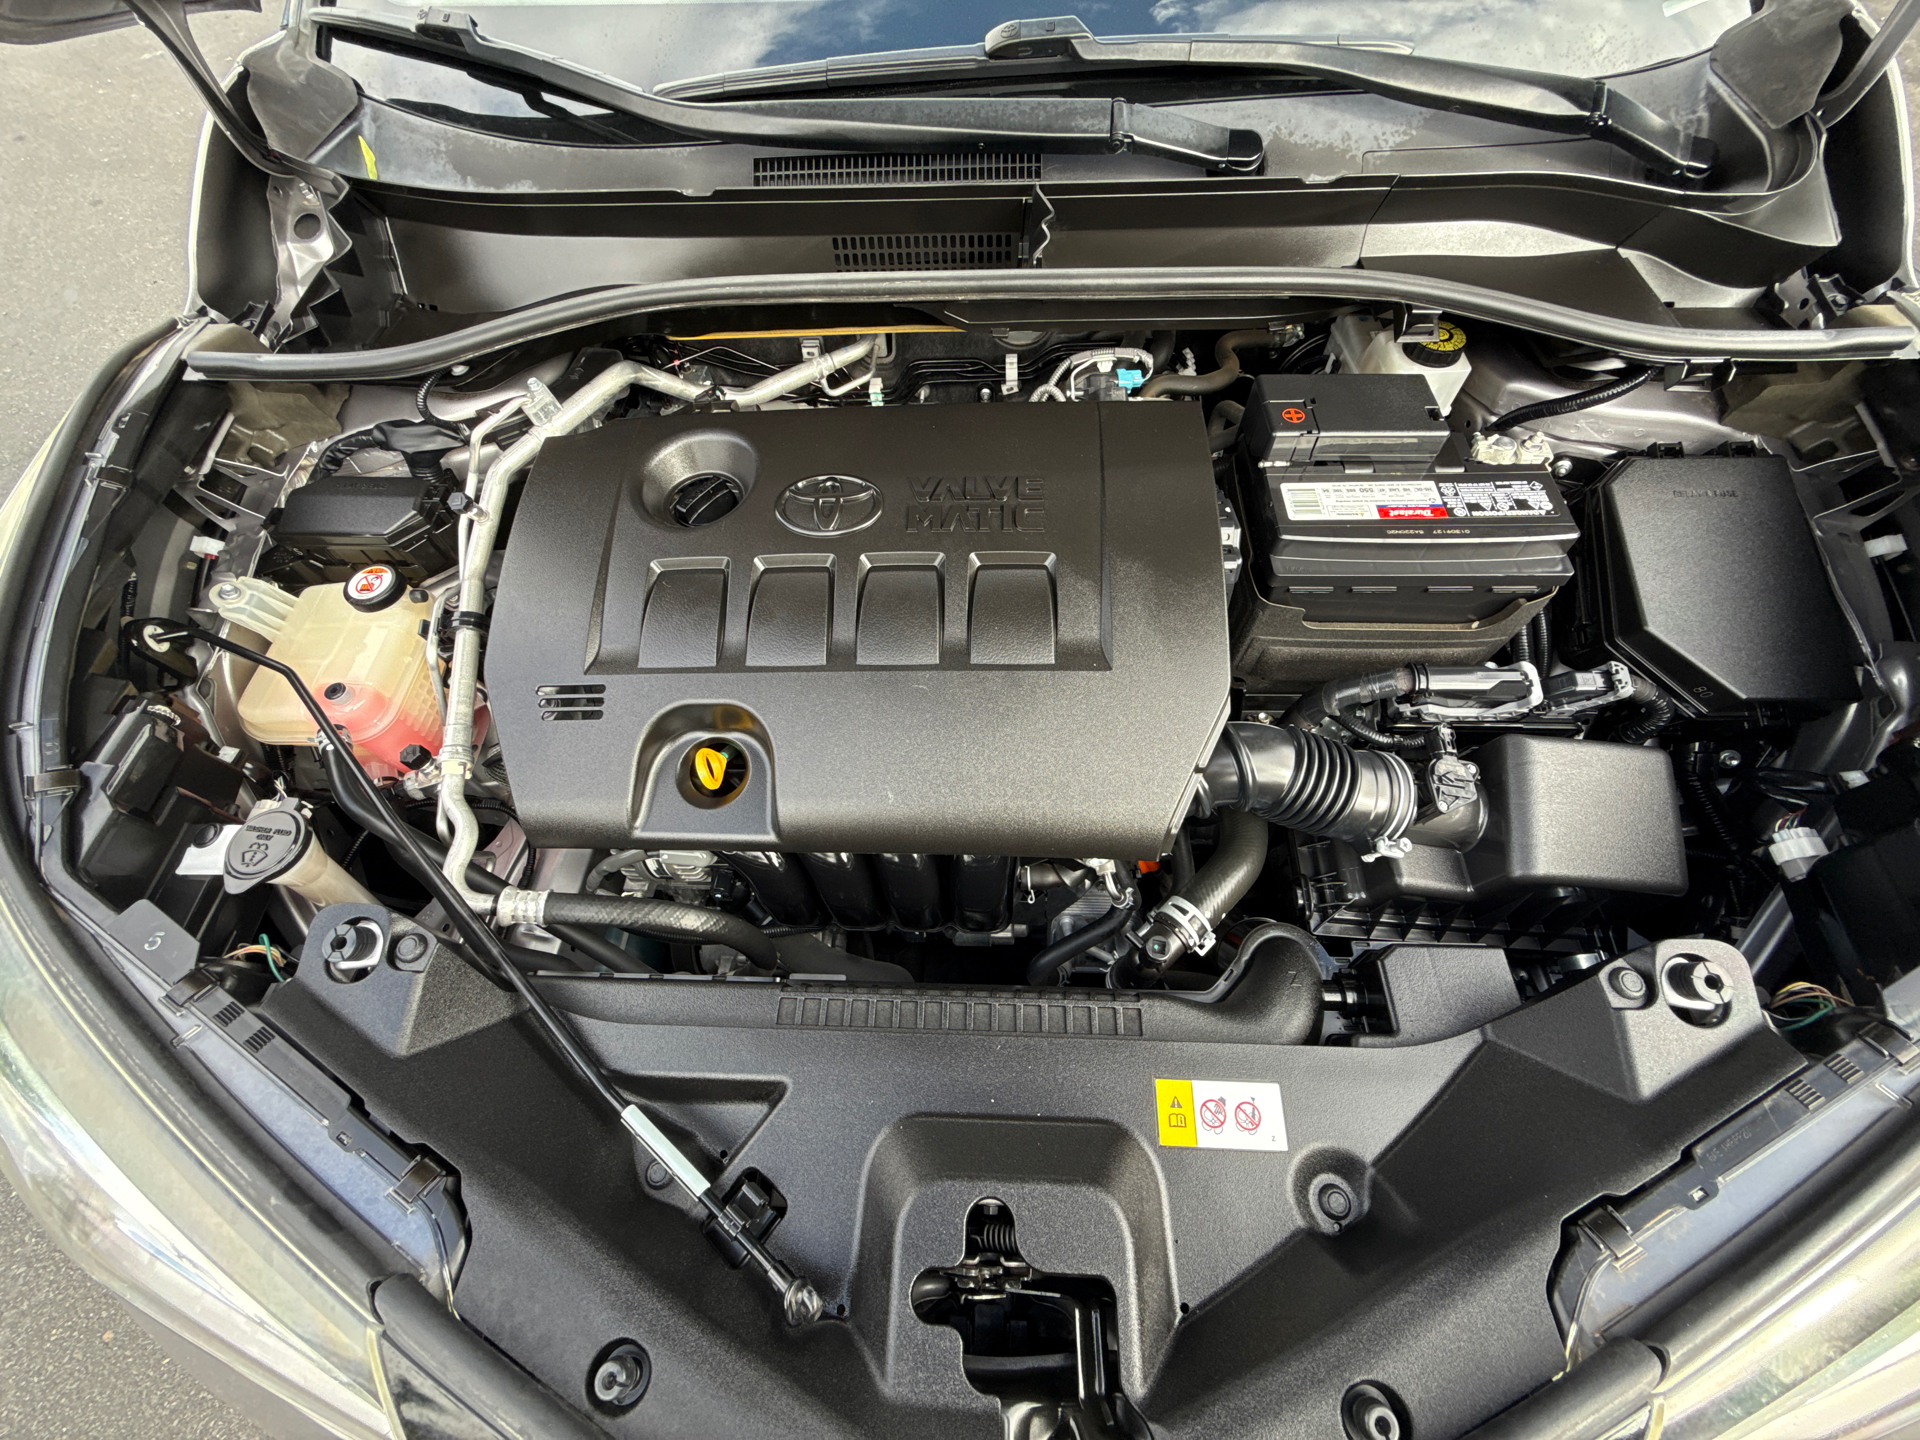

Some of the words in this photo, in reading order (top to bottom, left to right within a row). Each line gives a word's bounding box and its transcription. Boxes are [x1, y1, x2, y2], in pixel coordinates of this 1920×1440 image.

[907, 475, 1045, 503] VALVE
[906, 502, 1045, 533] MATIC
[1693, 686, 1714, 698] 80
[246, 825, 272, 834] WASHER
[273, 828, 292, 836] FLUID
[143, 930, 166, 951] 5
